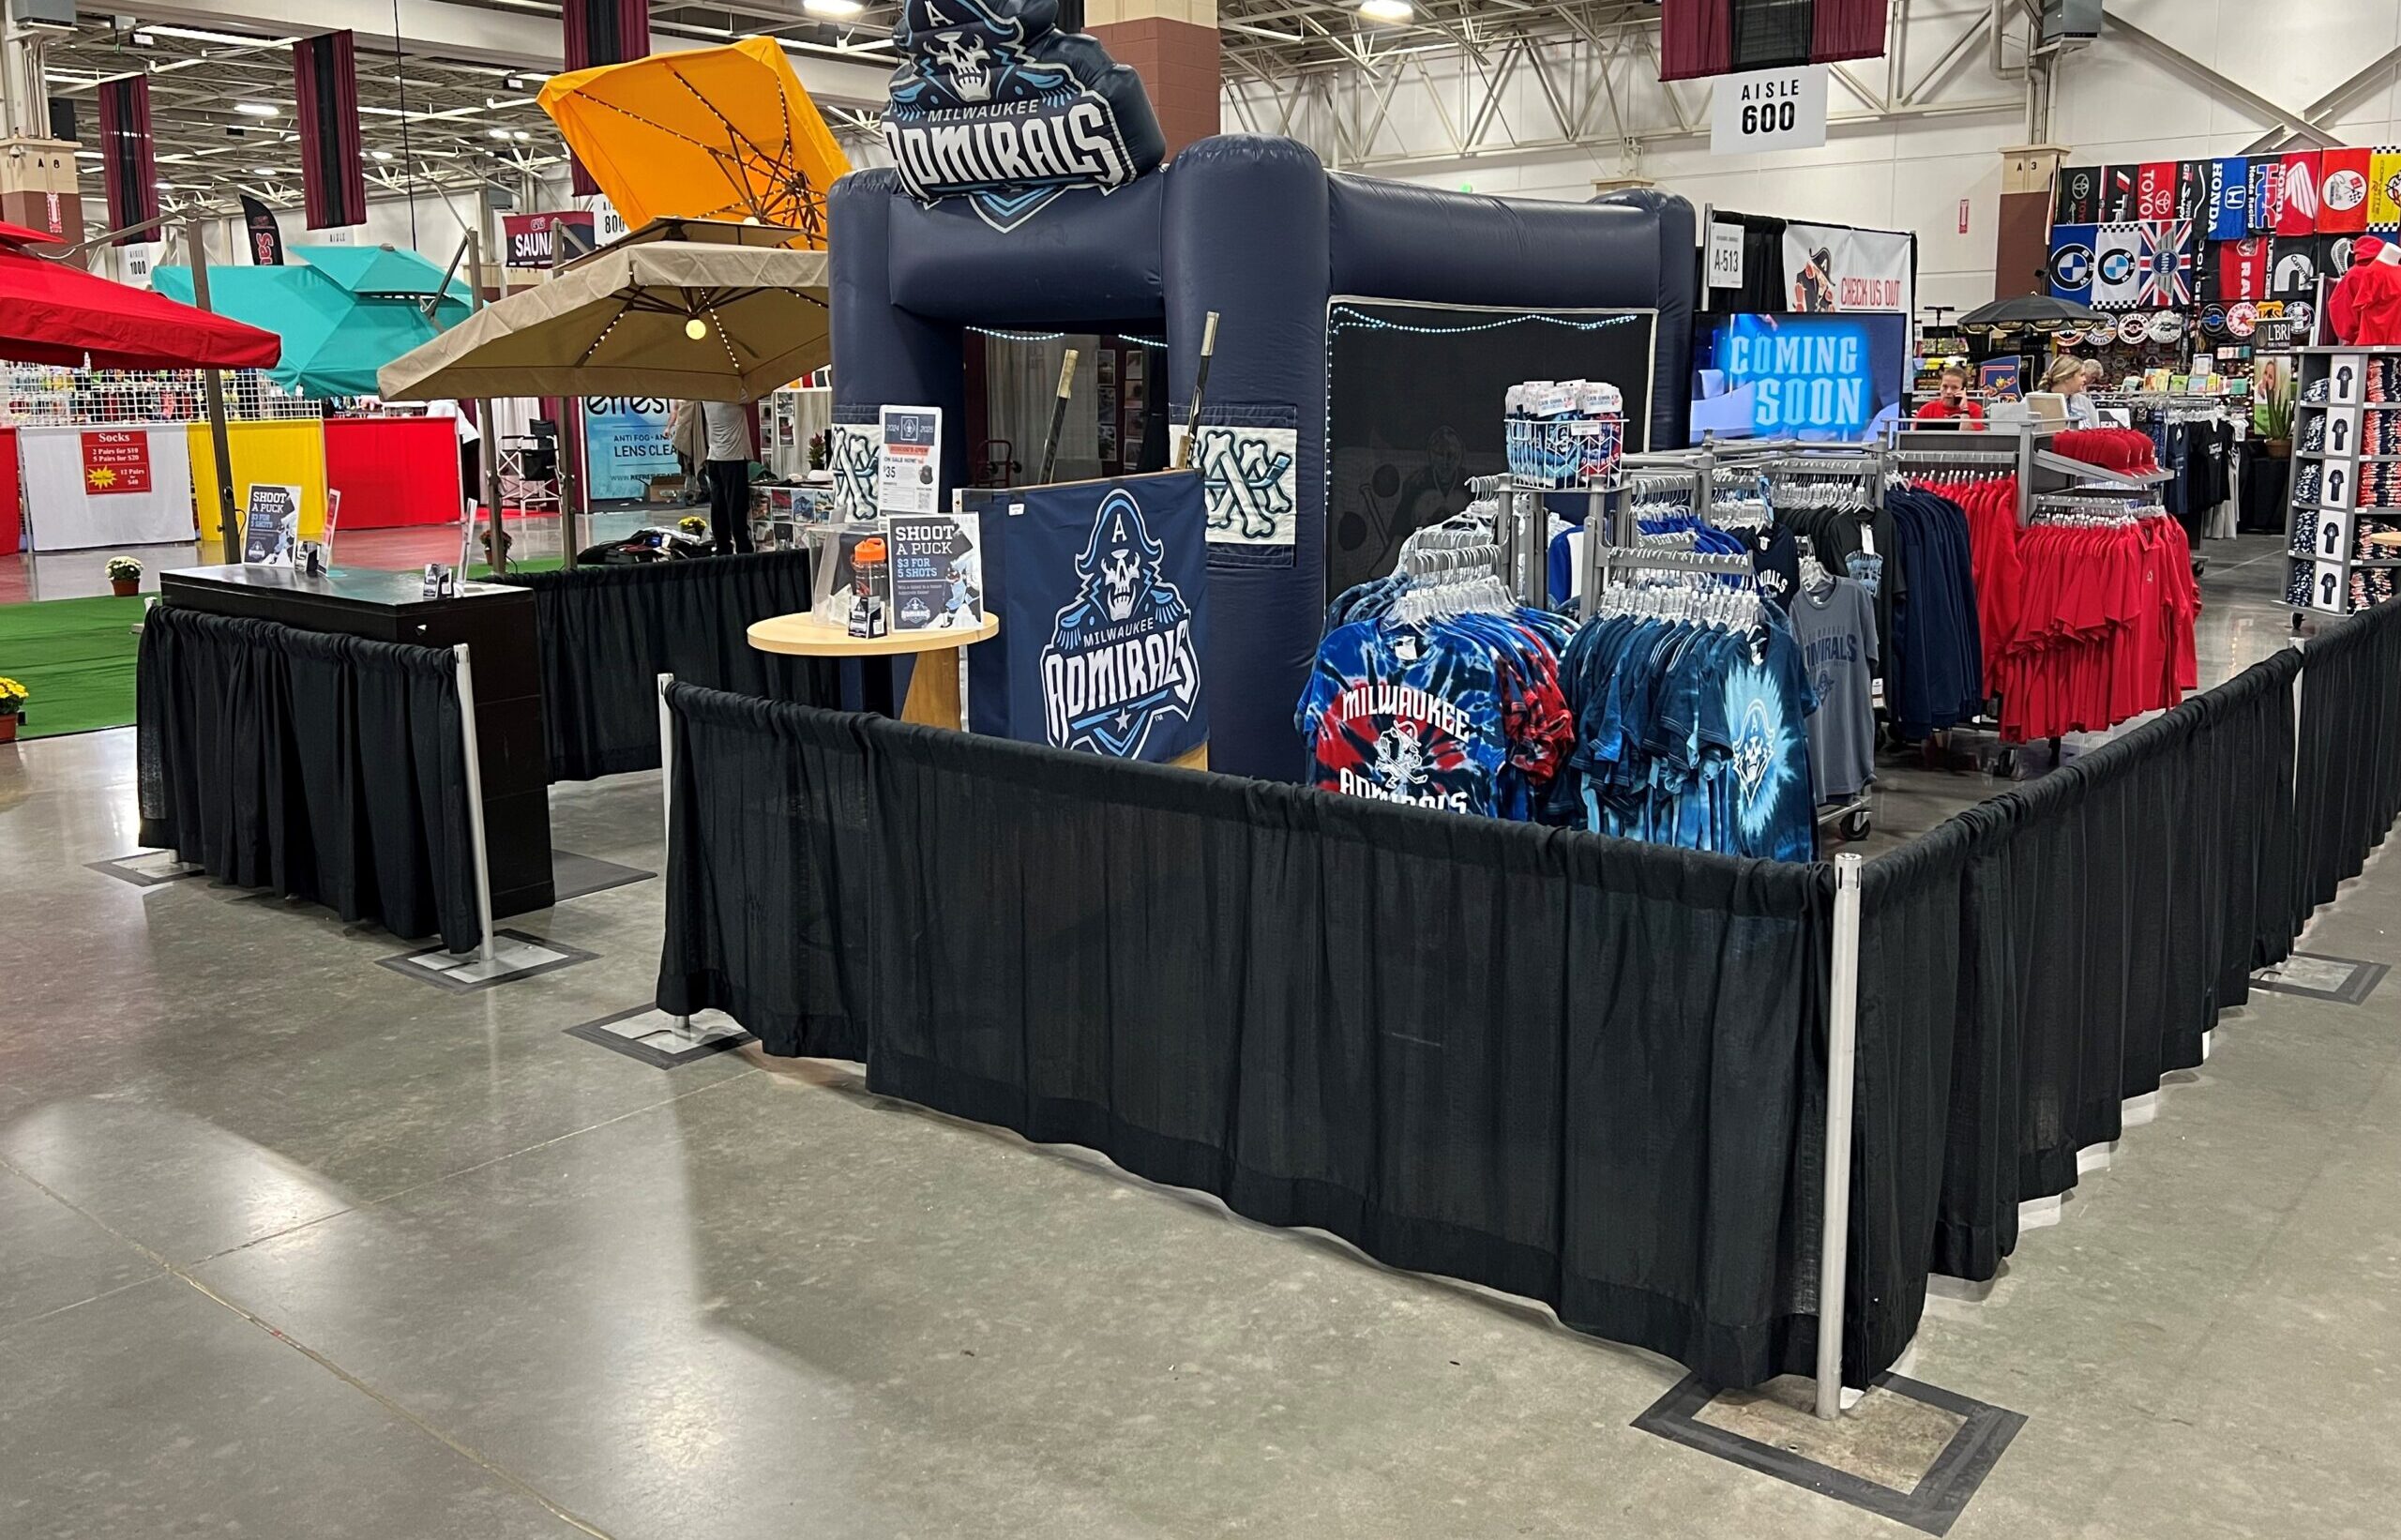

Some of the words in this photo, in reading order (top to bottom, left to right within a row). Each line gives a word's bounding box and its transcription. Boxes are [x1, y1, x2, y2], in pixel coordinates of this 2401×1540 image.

[1742, 79, 1800, 100] AISLE
[927, 98, 1040, 123] MILWAUKEE
[1742, 101, 1795, 134] 600
[881, 102, 1125, 200] ADMIRALS
[2031, 161, 2037, 171] 3
[2208, 162, 2223, 234] HONDA
[2275, 163, 2287, 224] HONDA
[604, 214, 626, 234] 800
[515, 231, 566, 258] SAUNA
[129, 261, 146, 275] 1000
[1714, 248, 1739, 272] A-513
[2160, 252, 2169, 274] MINI
[1840, 277, 1868, 306] CHECK
[1869, 279, 1881, 306] US
[1884, 279, 1901, 307] OUT
[2240, 262, 2252, 300] RA
[1729, 335, 1859, 375] COMING
[1755, 377, 1864, 426] SOON
[98, 432, 130, 443] Socks
[613, 445, 646, 458] LENS
[251, 504, 259, 512] A
[260, 504, 284, 513] PUCK
[252, 491, 287, 504] SHOOT
[895, 525, 956, 541] SHOOT
[1111, 513, 1127, 543] A
[896, 544, 908, 555] A
[911, 542, 953, 555] PUCK
[897, 558, 909, 567] $3
[911, 558, 931, 566] FOR
[898, 568, 904, 578] 5
[905, 567, 938, 578] SHOTS
[1083, 617, 1155, 648] MILWAUKEE
[1044, 619, 1196, 748] ADMIRALS
[1341, 685, 1471, 744] MILWAUKEE
